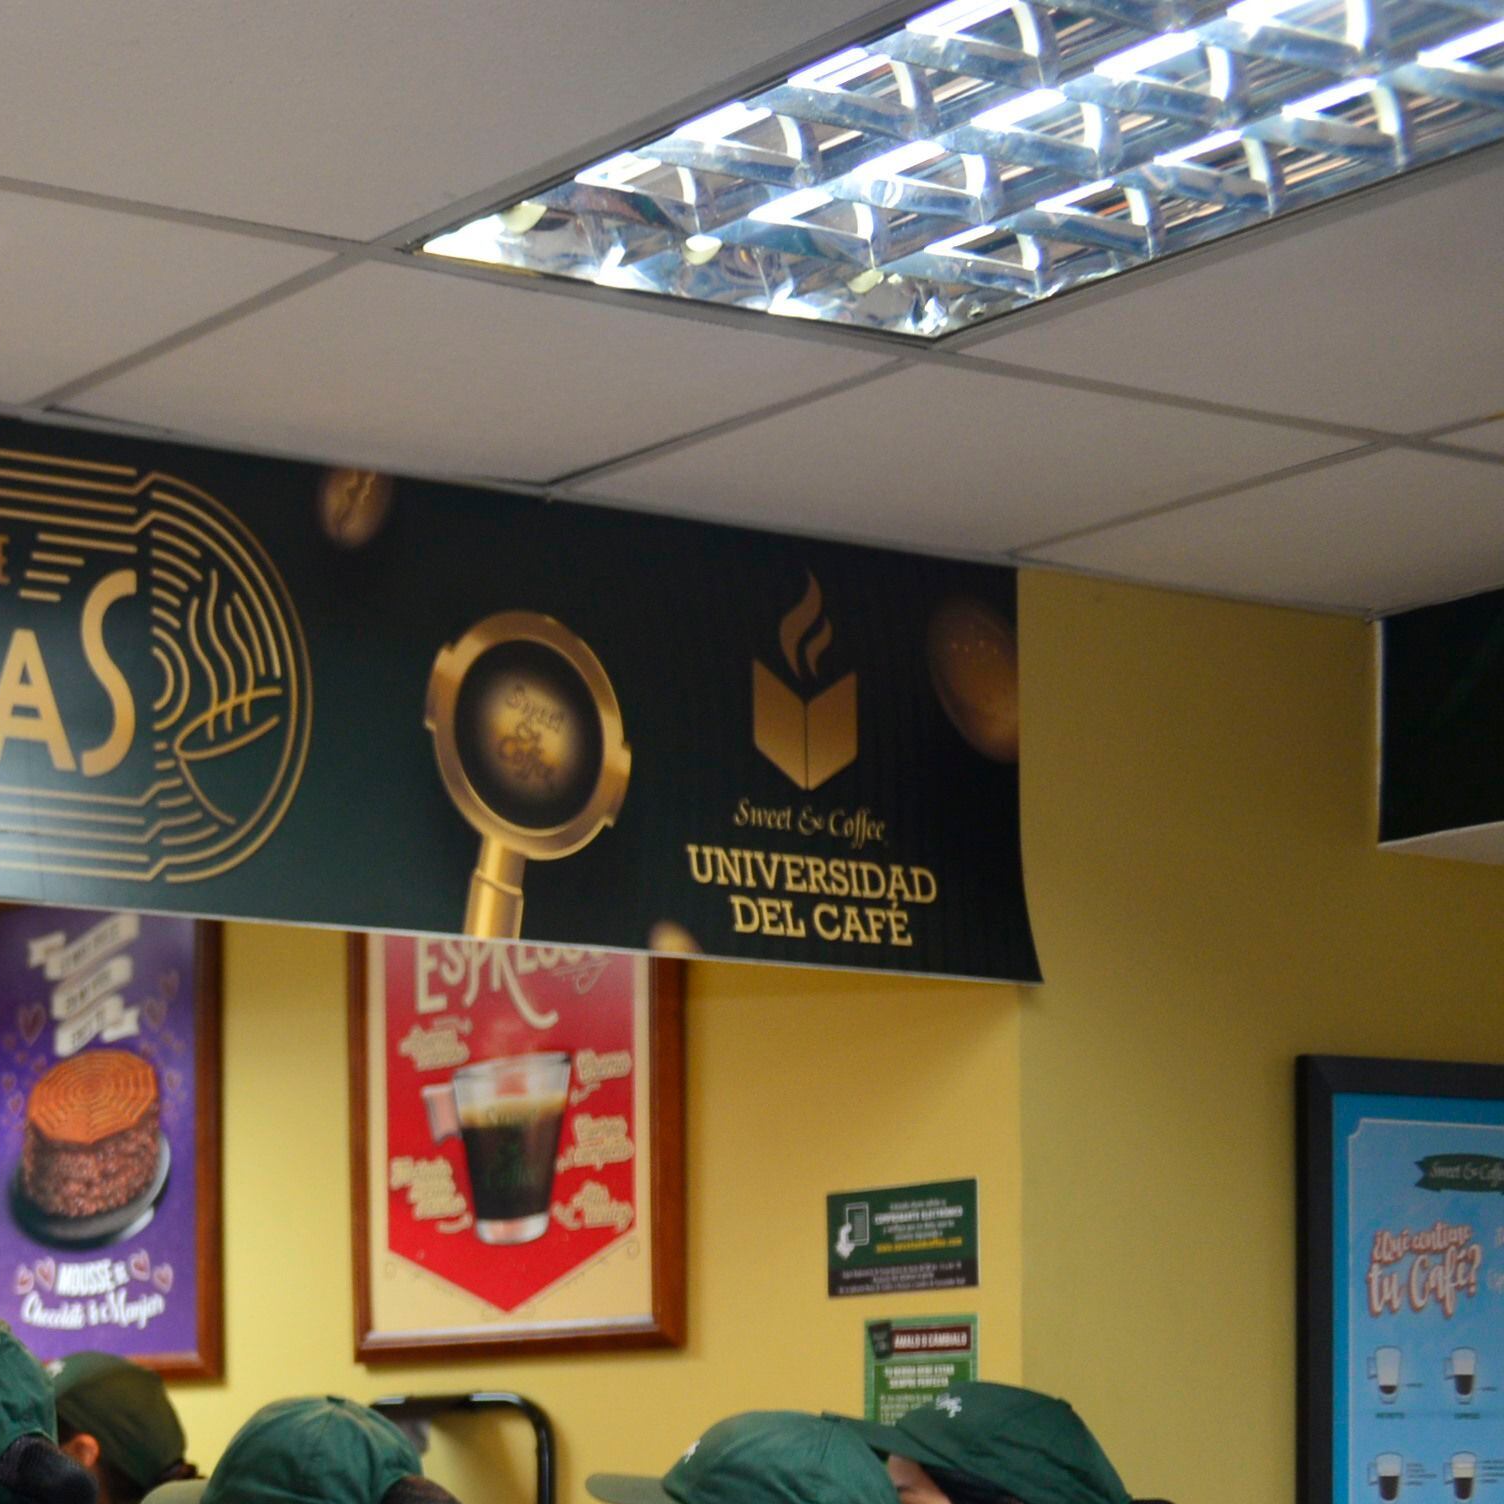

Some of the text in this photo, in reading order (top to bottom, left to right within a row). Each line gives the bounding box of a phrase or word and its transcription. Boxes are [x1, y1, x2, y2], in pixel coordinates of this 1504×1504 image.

[734, 798, 887, 850] Sweet & Coffee
[687, 843, 939, 904] UNIVERSIDAD
[730, 894, 914, 947] DEL CAFÉ
[56, 1258, 114, 1297] MOUSSE
[1367, 1242, 1482, 1319] tu Café?
